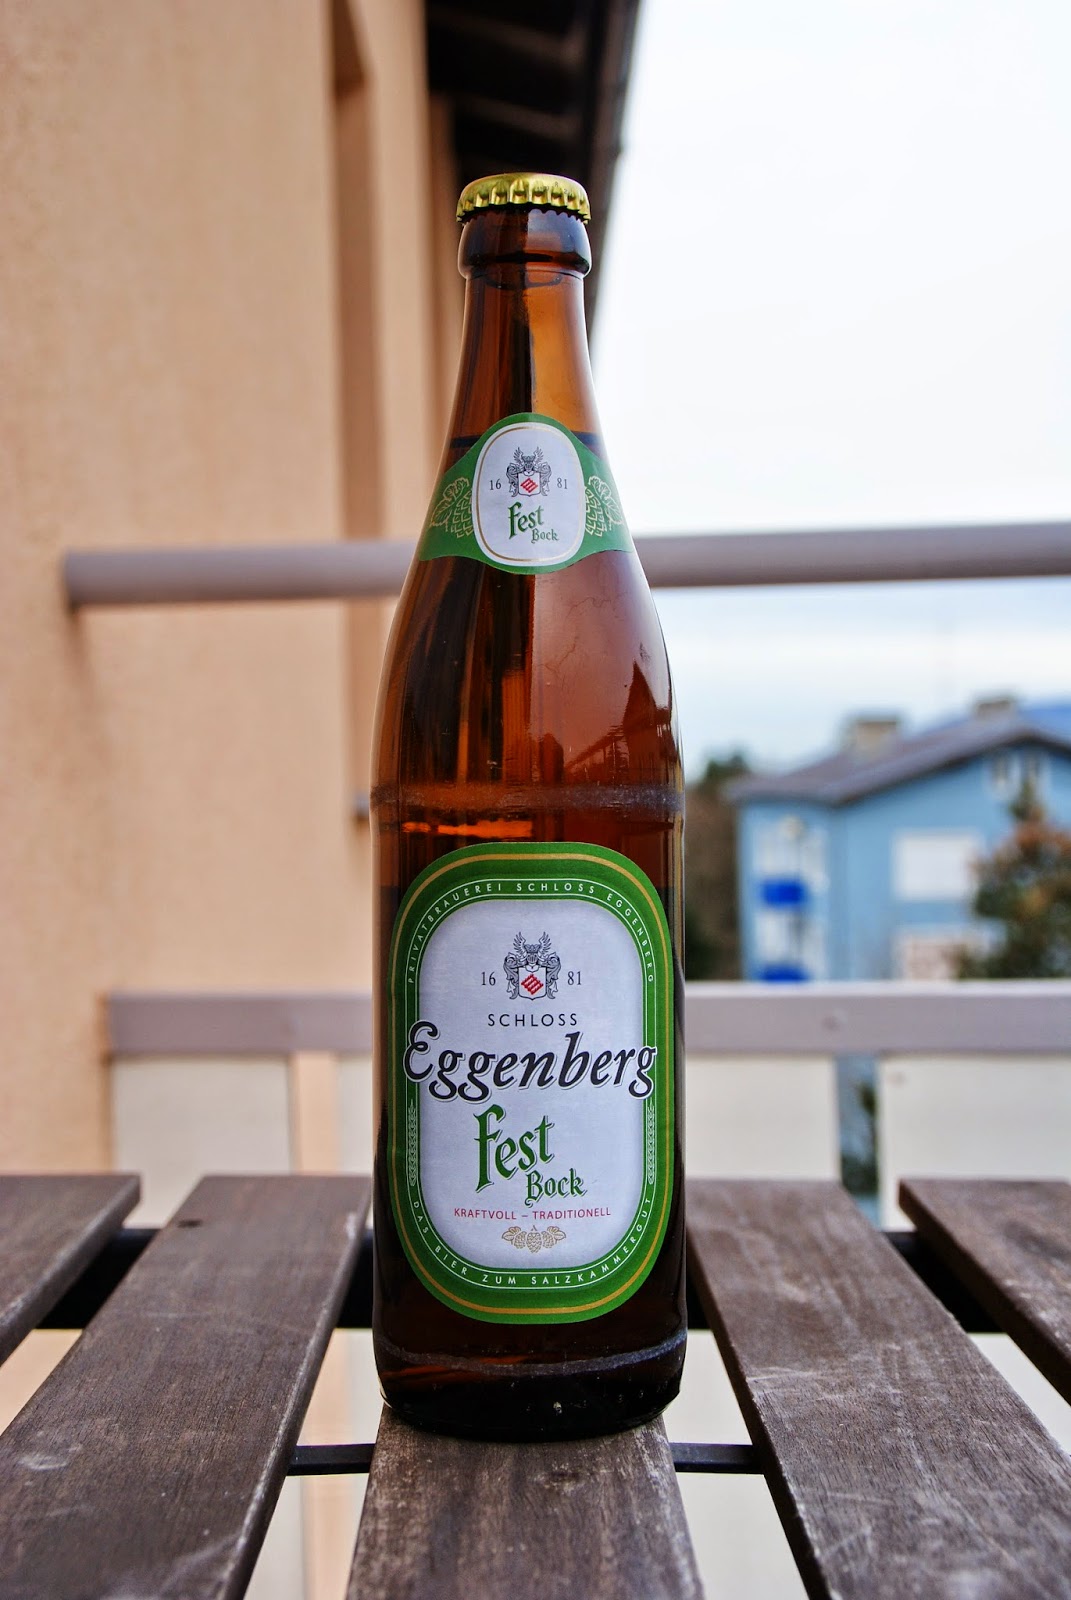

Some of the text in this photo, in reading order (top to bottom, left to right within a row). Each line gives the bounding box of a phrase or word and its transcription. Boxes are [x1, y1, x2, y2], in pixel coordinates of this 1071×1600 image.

[490, 479, 501, 490] 16
[557, 478, 568, 489] 81
[531, 529, 559, 544] Bock
[408, 883, 654, 983] PRIVATBRAUEREI SCHLOSS EGGENBERG
[481, 971, 496, 985] 16
[567, 971, 582, 985] 81
[487, 1013, 578, 1027] SCHLOSS
[403, 1020, 657, 1101] Eggenberg
[473, 1104, 554, 1193] Fest
[524, 1168, 587, 1207] Bock
[453, 1208, 517, 1220] KRAFTVOLL
[532, 1207, 611, 1220] TRADITIONELL
[413, 1198, 650, 1285] DAS BIER ZUM SALZKAMMERGUT
